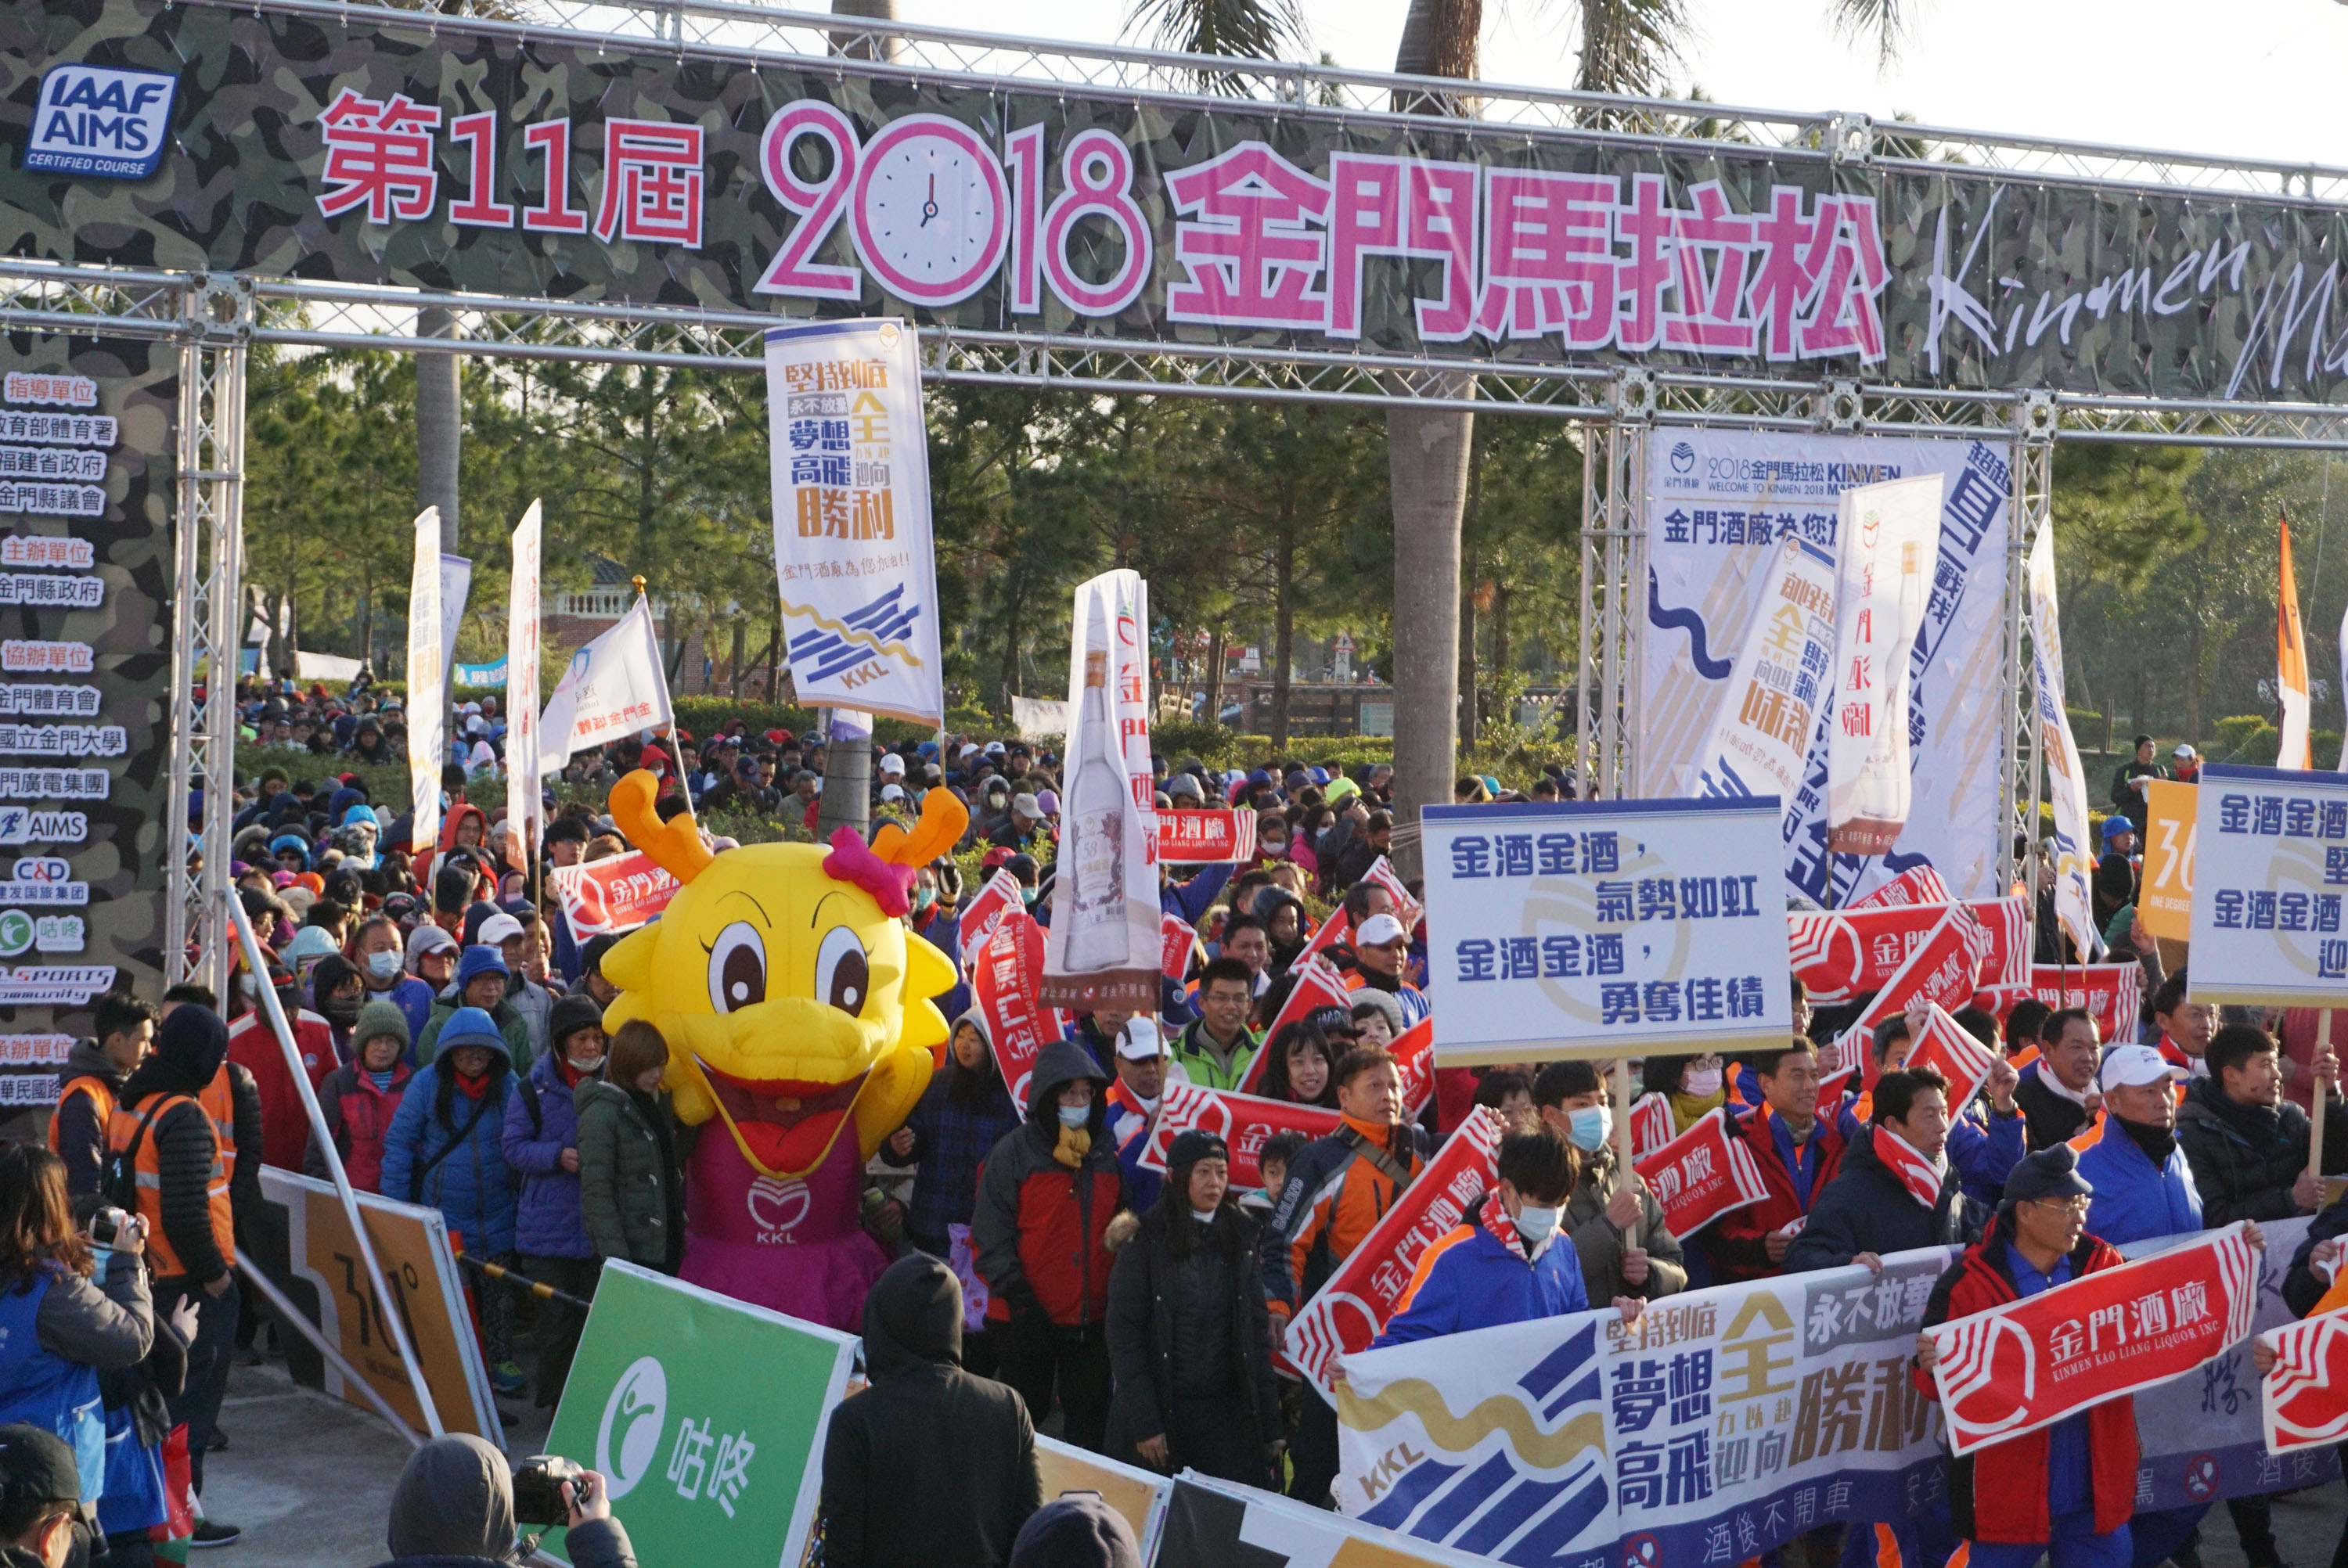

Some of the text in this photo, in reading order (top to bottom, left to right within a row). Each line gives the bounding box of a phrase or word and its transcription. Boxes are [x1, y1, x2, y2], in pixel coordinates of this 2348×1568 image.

[49, 74, 167, 114] IAAF
[42, 110, 148, 151] AIMS
[28, 154, 146, 174] CERTIFIED COURSE
[315, 87, 703, 250] 第11屆
[1163, 140, 1892, 365] 金門馬拉松
[1923, 184, 2251, 373] Kinmen
[8, 378, 93, 402] 指導單位
[786, 358, 888, 394] 堅持到底
[789, 419, 851, 451] 夢想
[790, 454, 852, 485] 高飛
[855, 461, 891, 487] 迎向
[1708, 481, 1749, 493] WELCOME
[1752, 483, 1764, 493] TO
[1767, 484, 1800, 494] KINMEN
[1804, 484, 1824, 495] 2018
[1828, 463, 1900, 484] KINMEN
[0, 484, 102, 512] 金門縣議會
[796, 486, 894, 540] 勝利
[5, 540, 90, 564] 主辦單位
[0, 577, 100, 602] 金門縣政府
[5, 644, 89, 667] 協辦單位
[840, 661, 889, 690] KKL
[0, 687, 97, 711] 金門體育會
[0, 728, 123, 752] 國立金門大學
[29, 816, 83, 837] AIMS
[17, 861, 66, 883] C&D
[610, 866, 680, 907] 金門酒
[1596, 875, 1759, 922] 氣勢如虹
[2150, 894, 2191, 913] ONE DEGREE
[2213, 888, 2343, 933] 金酒金酒
[41, 920, 80, 939] 咕咚
[16, 969, 112, 985] SPORTS
[1601, 974, 1765, 1025] 勇奪佳績
[1670, 1185, 1708, 1213] LIQUOR
[757, 1231, 796, 1244] KKL
[1808, 1271, 1937, 1345] 永不放棄
[2050, 1281, 2212, 1366] 金門酒廠
[1606, 1300, 1717, 1356] 堅持到底
[1718, 1289, 1796, 1404] 全
[2052, 1357, 2092, 1383] KINMEN
[2096, 1350, 2116, 1366] KAO
[2119, 1340, 2151, 1359] LIANG
[2154, 1327, 2195, 1348] LIQUOR
[1611, 1348, 1713, 1435] 夢想
[1788, 1352, 1944, 1469] 勝利
[667, 1417, 756, 1519] 咕咚
[1358, 1442, 1424, 1502] KKL
[1615, 1428, 1712, 1516] 高飛
[1714, 1430, 1788, 1488] 迎向
[2256, 1448, 2340, 1486] 酒後
[1703, 1478, 1853, 1565] 酒後不開車
